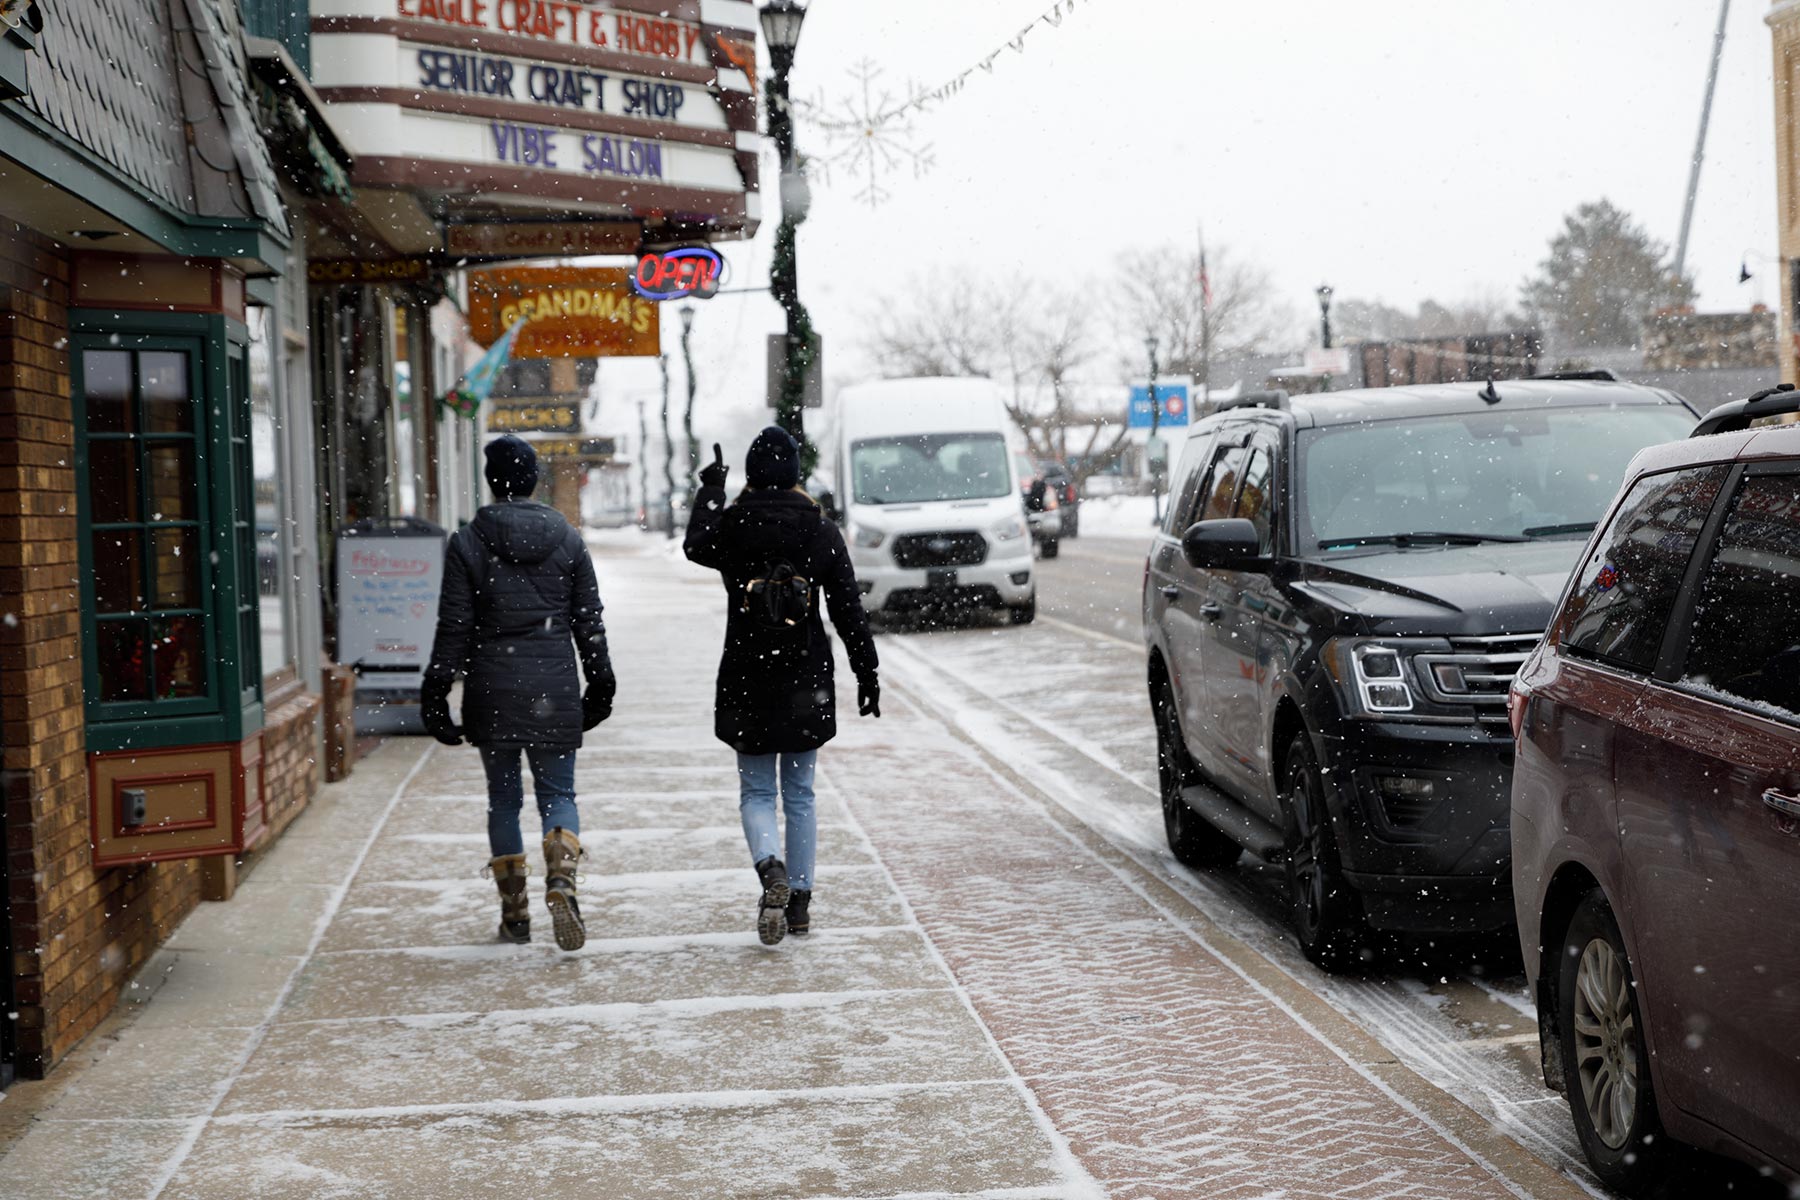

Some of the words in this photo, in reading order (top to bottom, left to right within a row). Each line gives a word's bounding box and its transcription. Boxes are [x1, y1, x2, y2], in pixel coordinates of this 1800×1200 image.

[498, 0, 583, 43] CRAFT
[590, 11, 607, 46] &
[616, 16, 701, 61] HOBBY
[418, 50, 515, 98] SENIOR
[528, 65, 609, 110] CRAFT
[622, 79, 684, 118] SHOP
[491, 122, 558, 168] VIBE
[582, 135, 664, 178] SALON
[637, 254, 717, 291] OPEN
